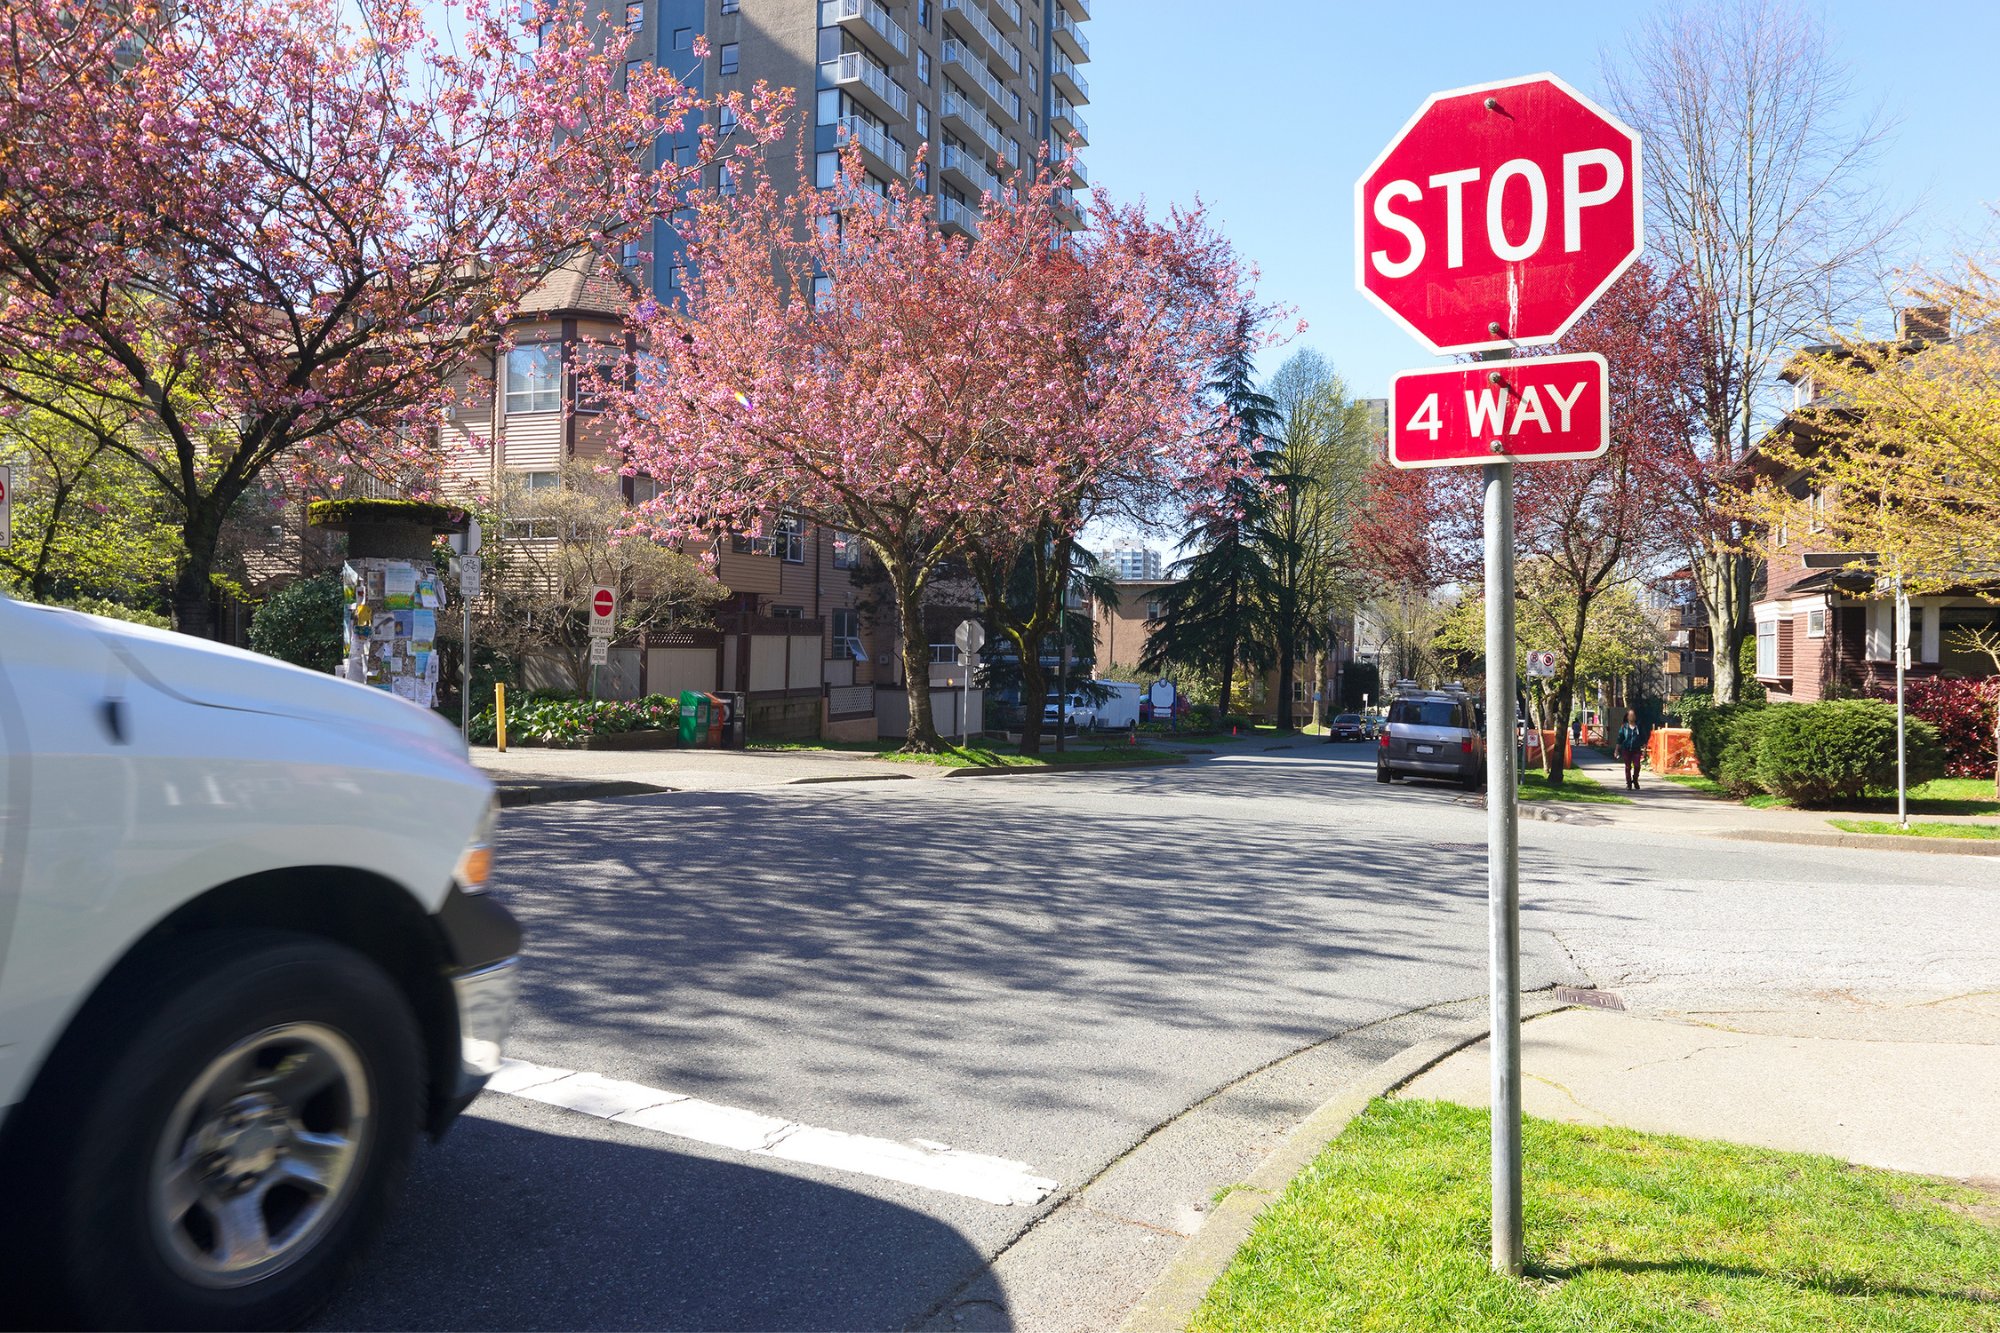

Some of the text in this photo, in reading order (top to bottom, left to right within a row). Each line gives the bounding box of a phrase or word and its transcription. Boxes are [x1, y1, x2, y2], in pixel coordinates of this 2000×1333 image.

[1371, 147, 1624, 279] STOP
[1406, 381, 1588, 441] 4 WAY
